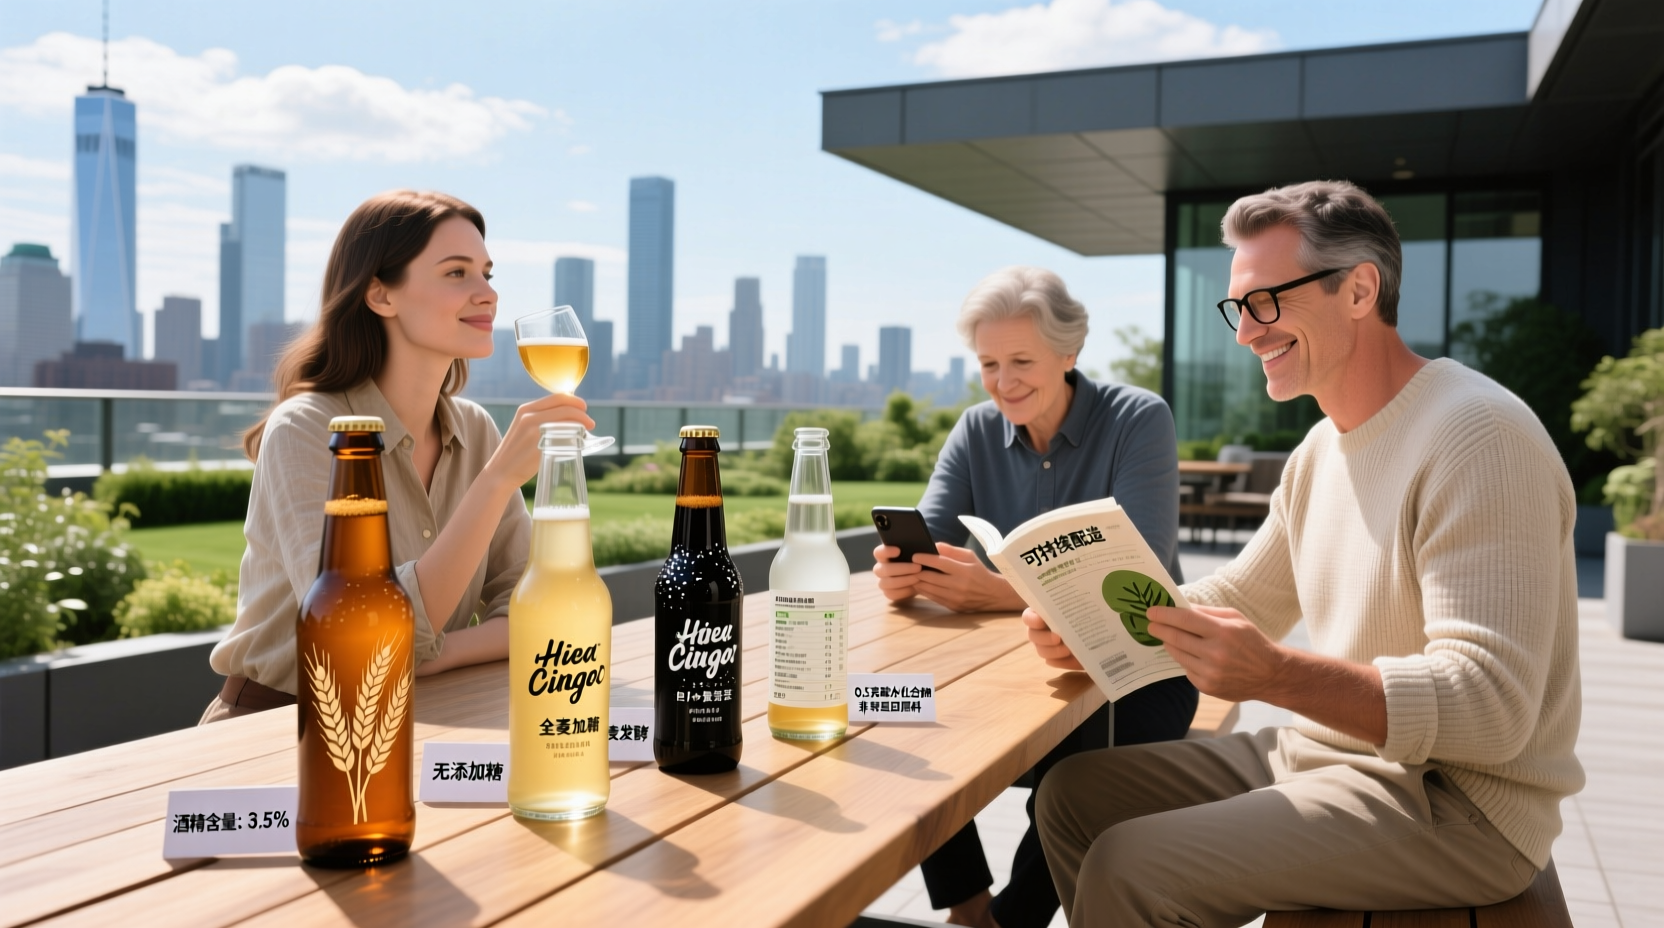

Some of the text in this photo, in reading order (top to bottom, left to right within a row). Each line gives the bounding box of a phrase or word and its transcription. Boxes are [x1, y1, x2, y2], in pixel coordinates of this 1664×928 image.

[432, 760, 504, 782] 无添加糖
[173, 811, 290, 833] 酒精含量: 3.5%
